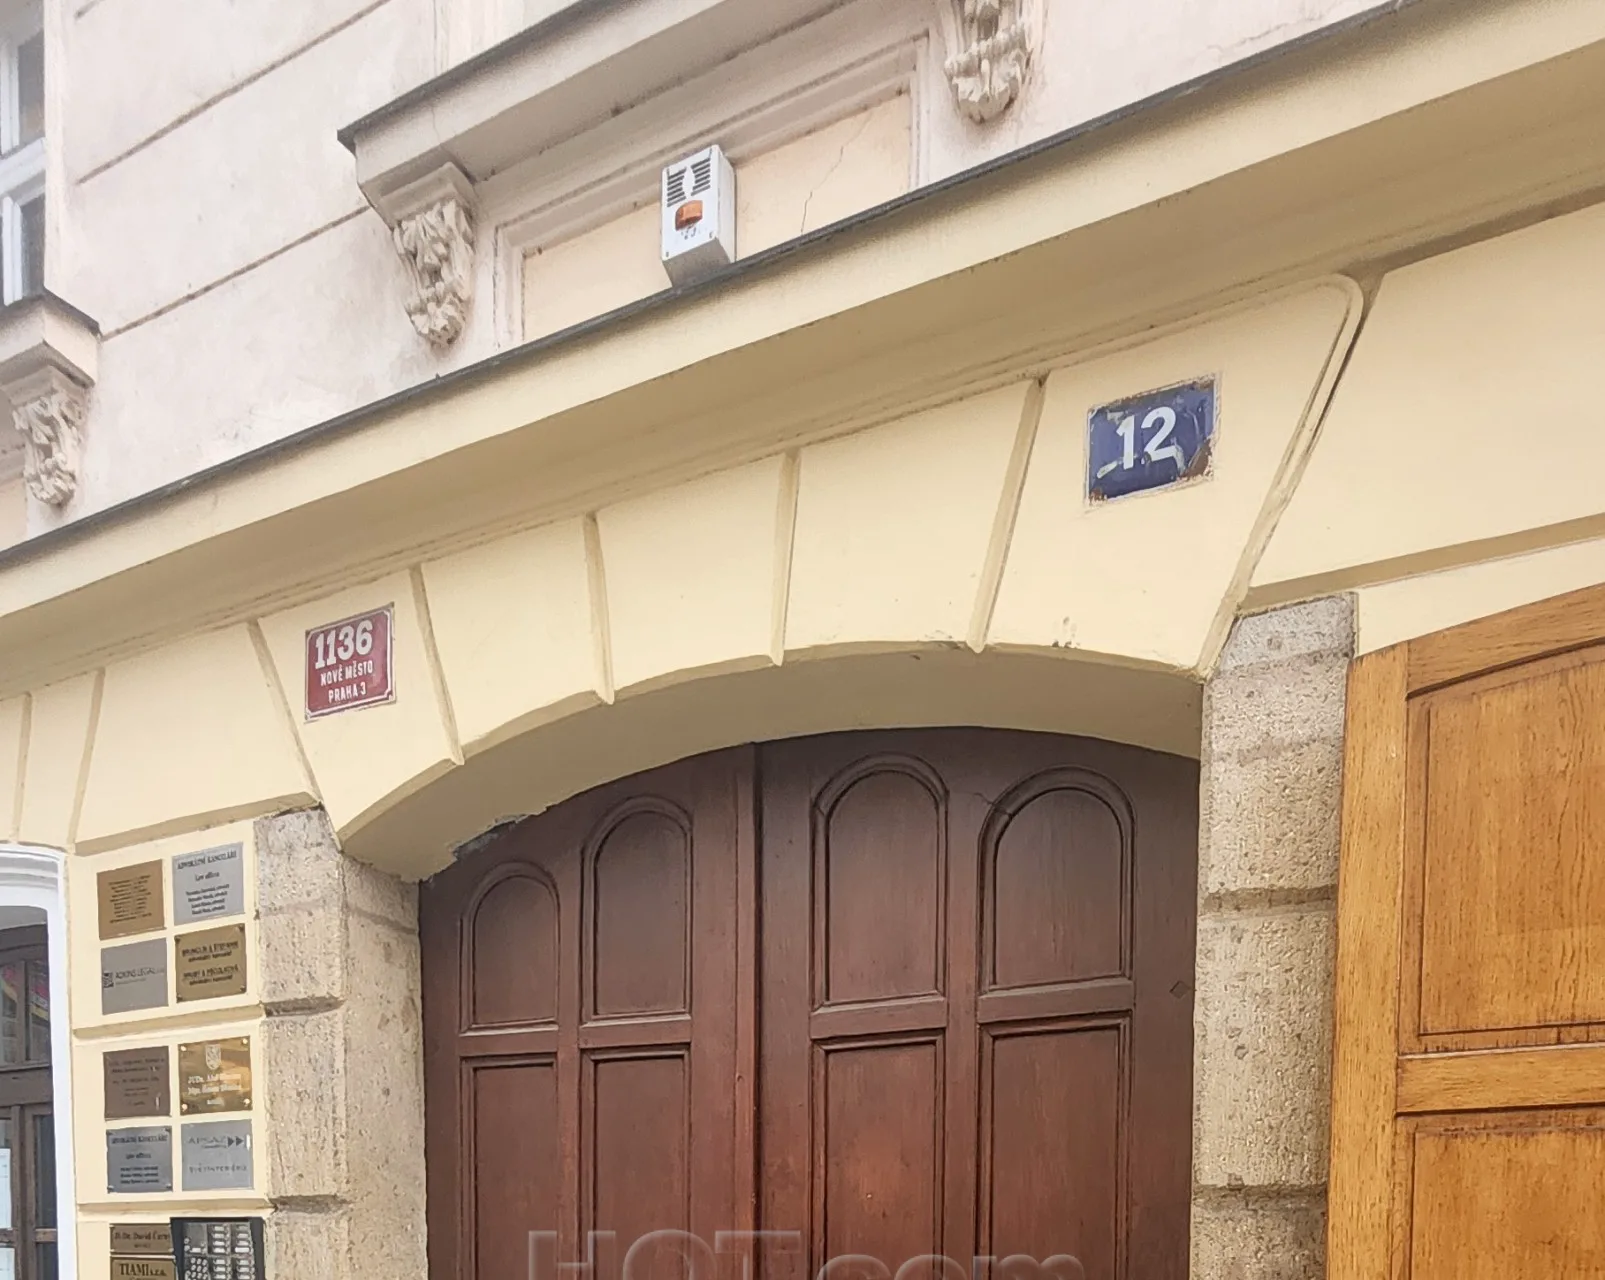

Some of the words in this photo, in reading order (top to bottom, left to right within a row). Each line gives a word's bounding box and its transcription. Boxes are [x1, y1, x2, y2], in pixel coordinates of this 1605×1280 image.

[1115, 406, 1177, 470] 12
[314, 619, 374, 670] 1136
[320, 663, 343, 687] NOVÉ
[345, 660, 373, 680] MĚSTO
[328, 683, 359, 703] PRAHA
[360, 681, 367, 695] 3
